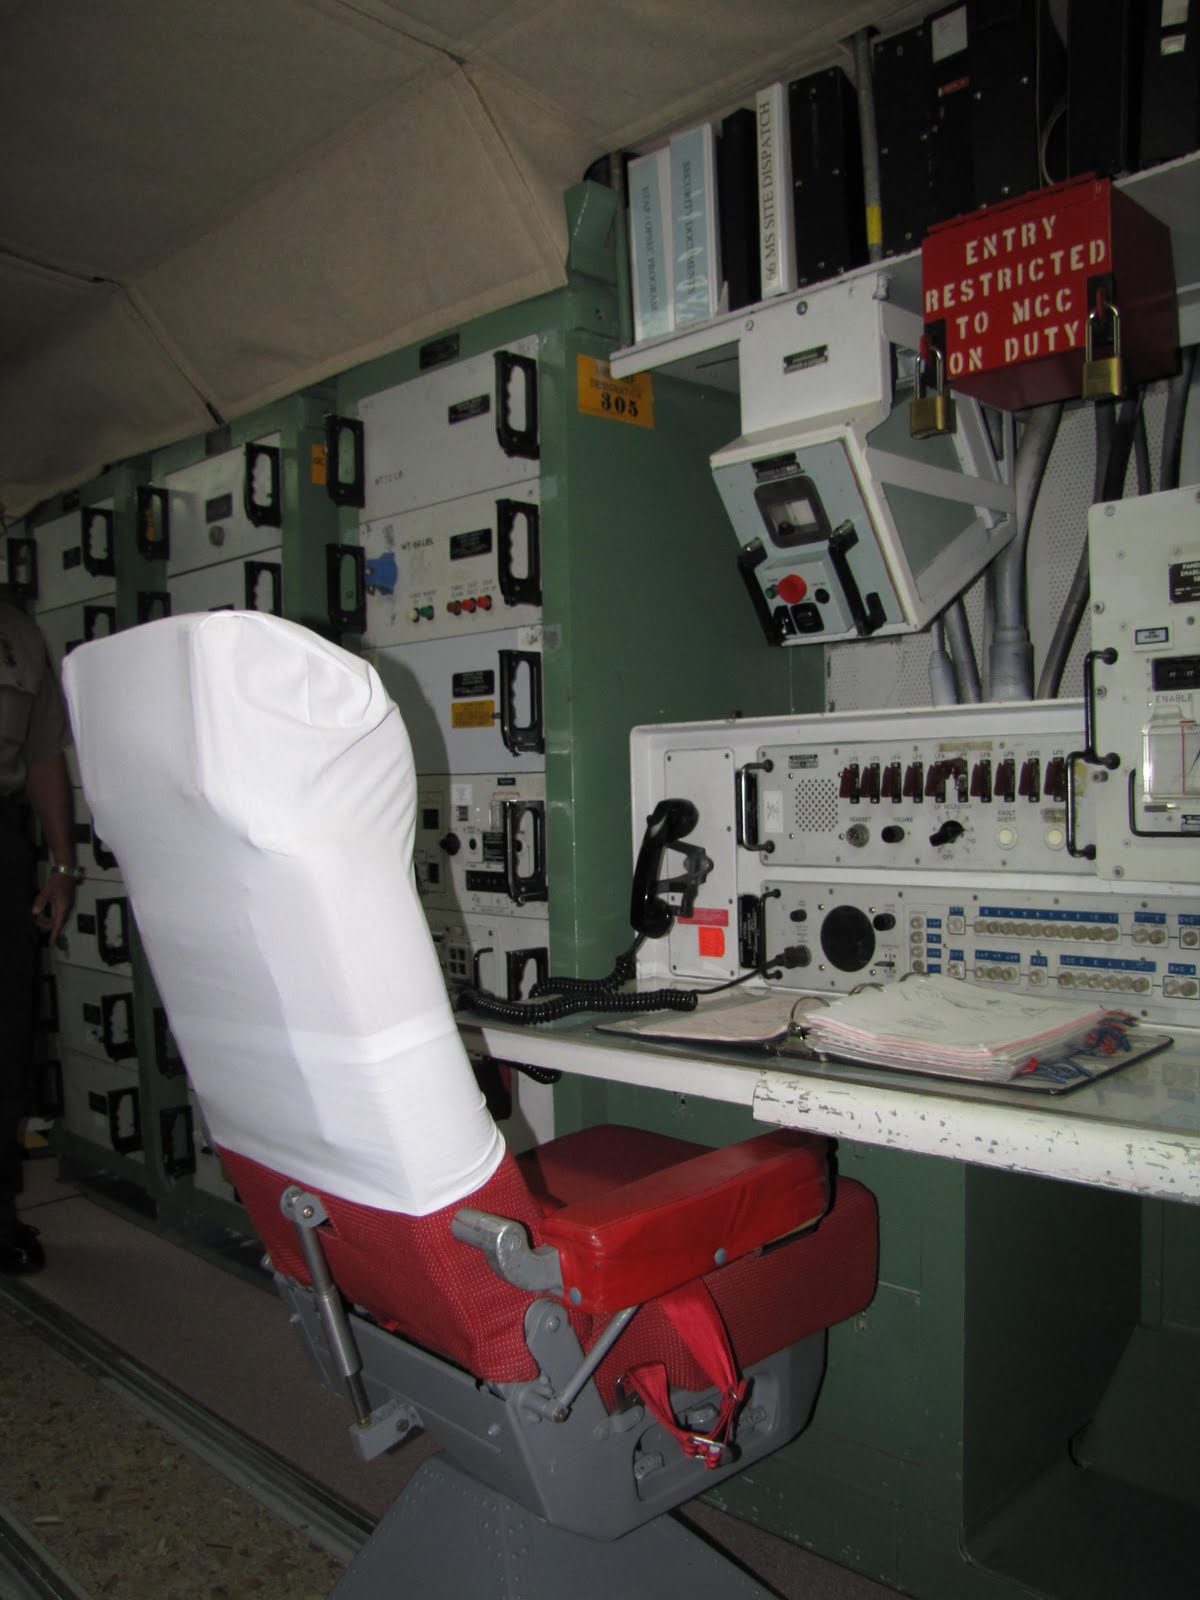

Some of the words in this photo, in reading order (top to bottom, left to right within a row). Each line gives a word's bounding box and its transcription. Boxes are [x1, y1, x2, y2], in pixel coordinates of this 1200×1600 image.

[760, 102, 773, 188] DISPATCH
[763, 191, 774, 230] SITE
[764, 232, 776, 260] MS
[966, 215, 1056, 266] ENTRY
[767, 264, 777, 281] 66
[925, 239, 1105, 314] RESTRICTED
[956, 311, 989, 340] TO
[1012, 288, 1073, 325] MCC
[949, 346, 982, 375] ON
[1005, 320, 1079, 363] DUTY
[601, 392, 638, 418] 305
[1155, 693, 1193, 703] ENABLE
